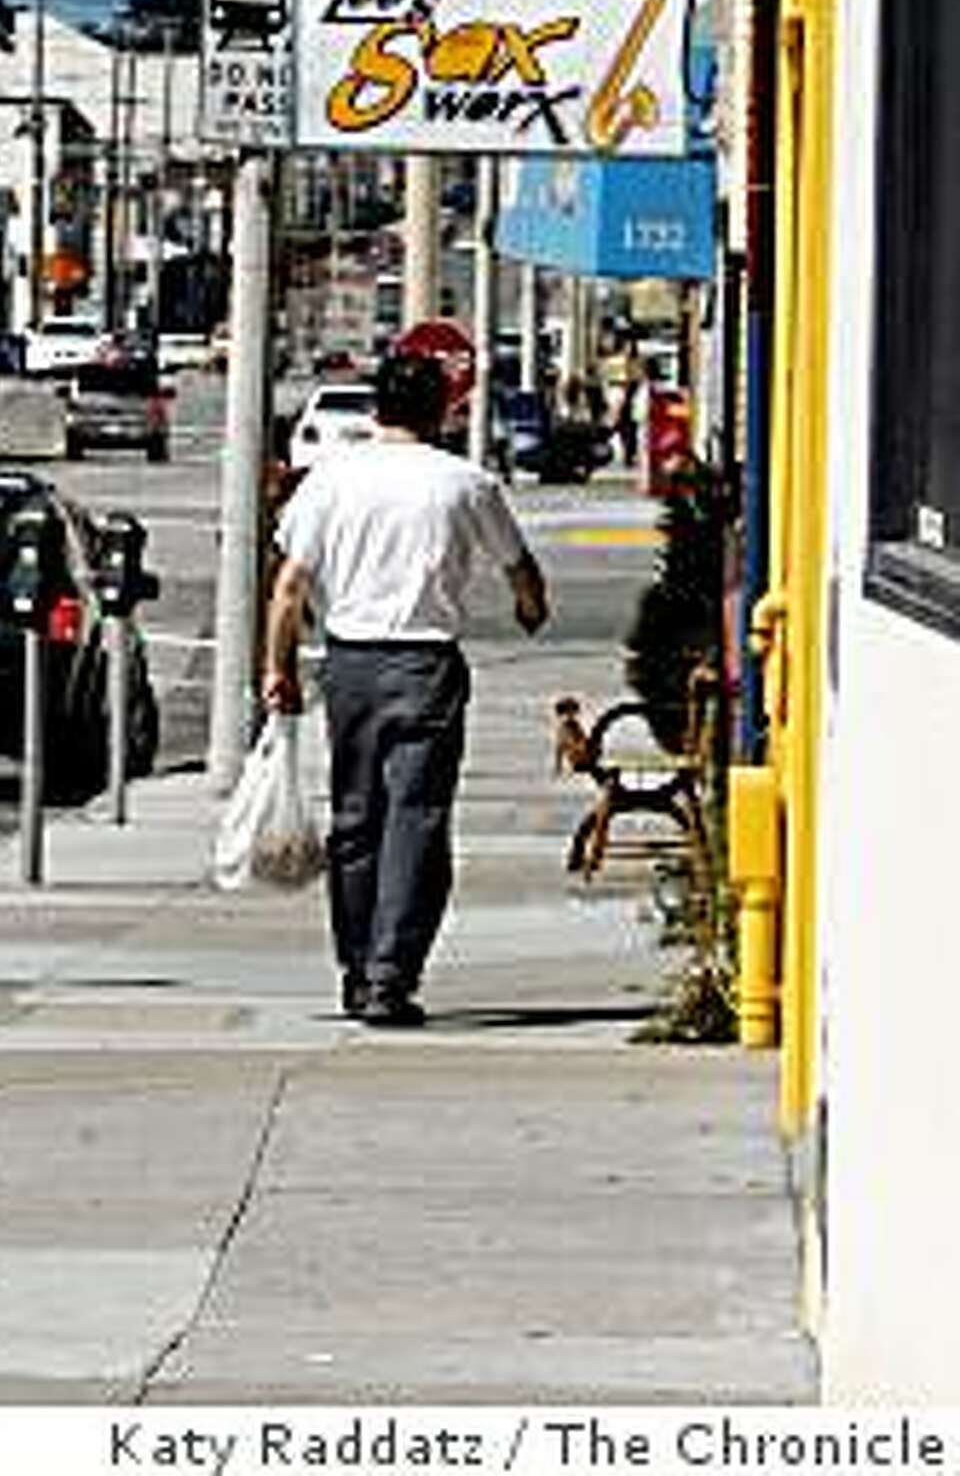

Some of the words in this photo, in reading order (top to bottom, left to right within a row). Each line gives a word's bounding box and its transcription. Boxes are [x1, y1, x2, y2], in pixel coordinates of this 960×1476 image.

[210, 61, 245, 87] DO
[327, 17, 581, 132] Sax
[225, 90, 291, 117] PASS
